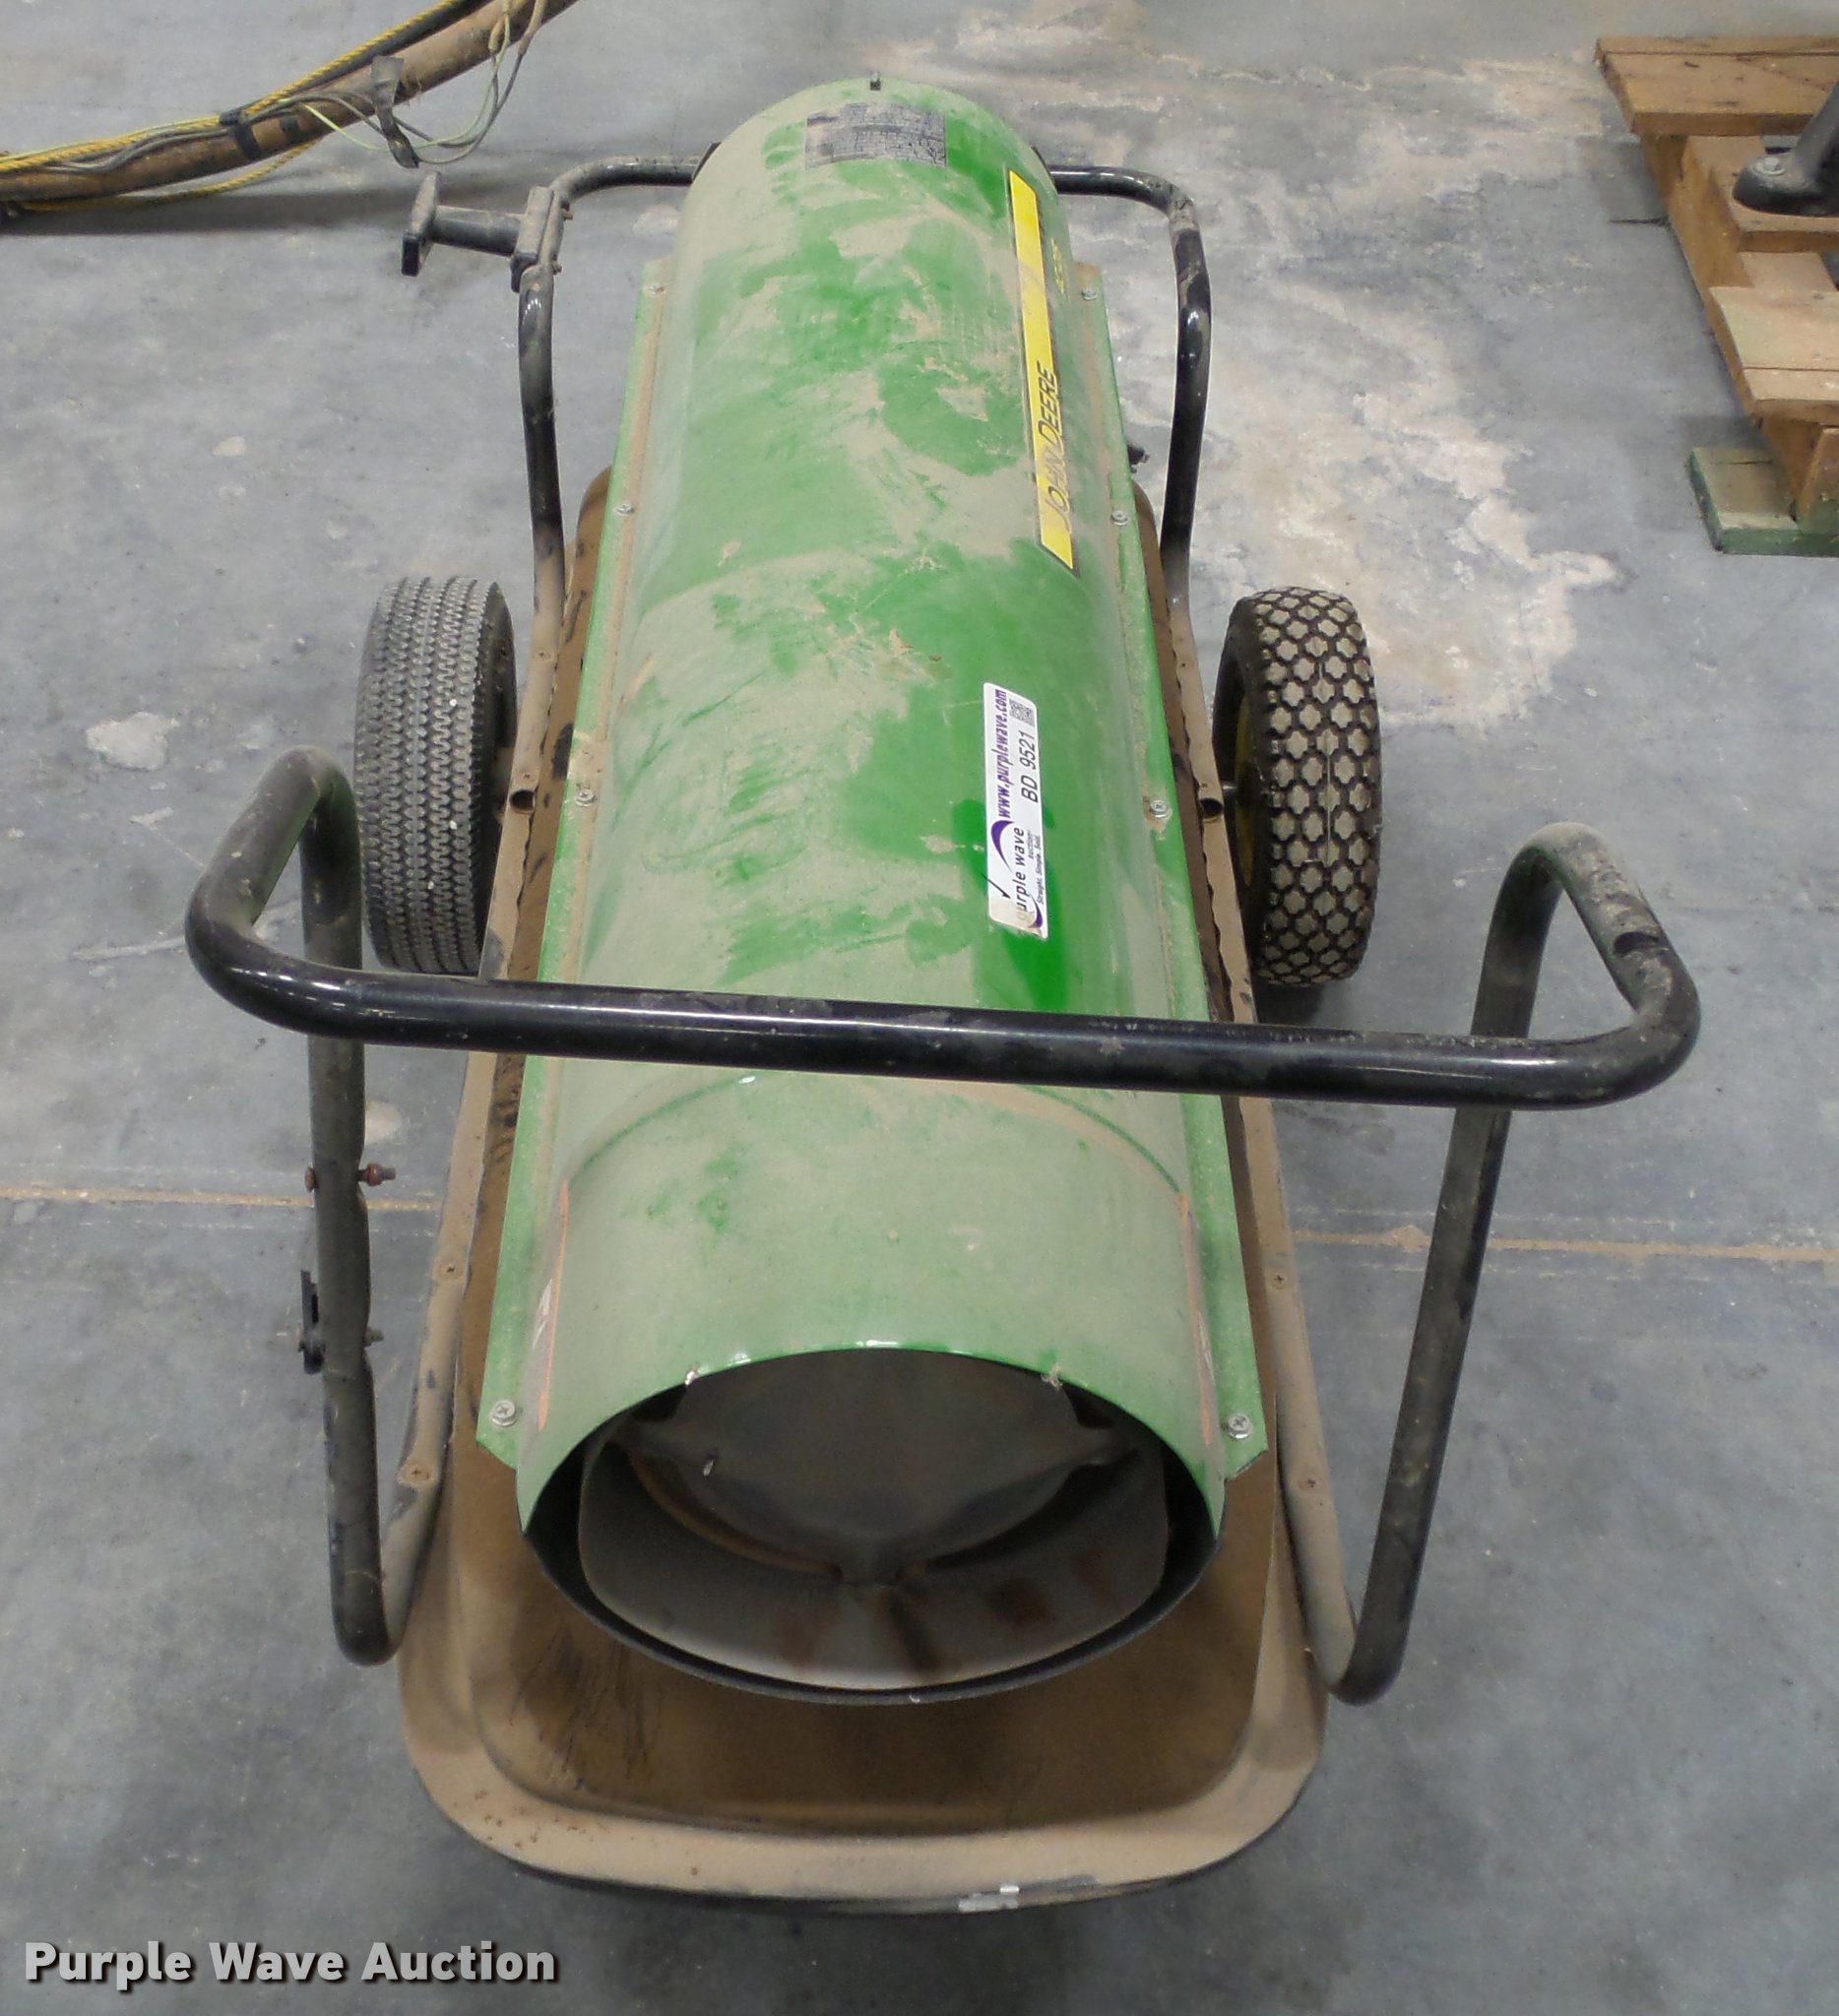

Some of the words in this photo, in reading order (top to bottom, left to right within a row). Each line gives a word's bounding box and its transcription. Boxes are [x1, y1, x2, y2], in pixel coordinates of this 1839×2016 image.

[1037, 360, 1063, 449] DEERE
[1042, 444, 1069, 532] JOHN
[991, 688, 1014, 819] www.purplewave.com
[1018, 729, 1037, 771] 9521
[1020, 774, 1039, 803] BD
[1013, 827, 1026, 867] wave
